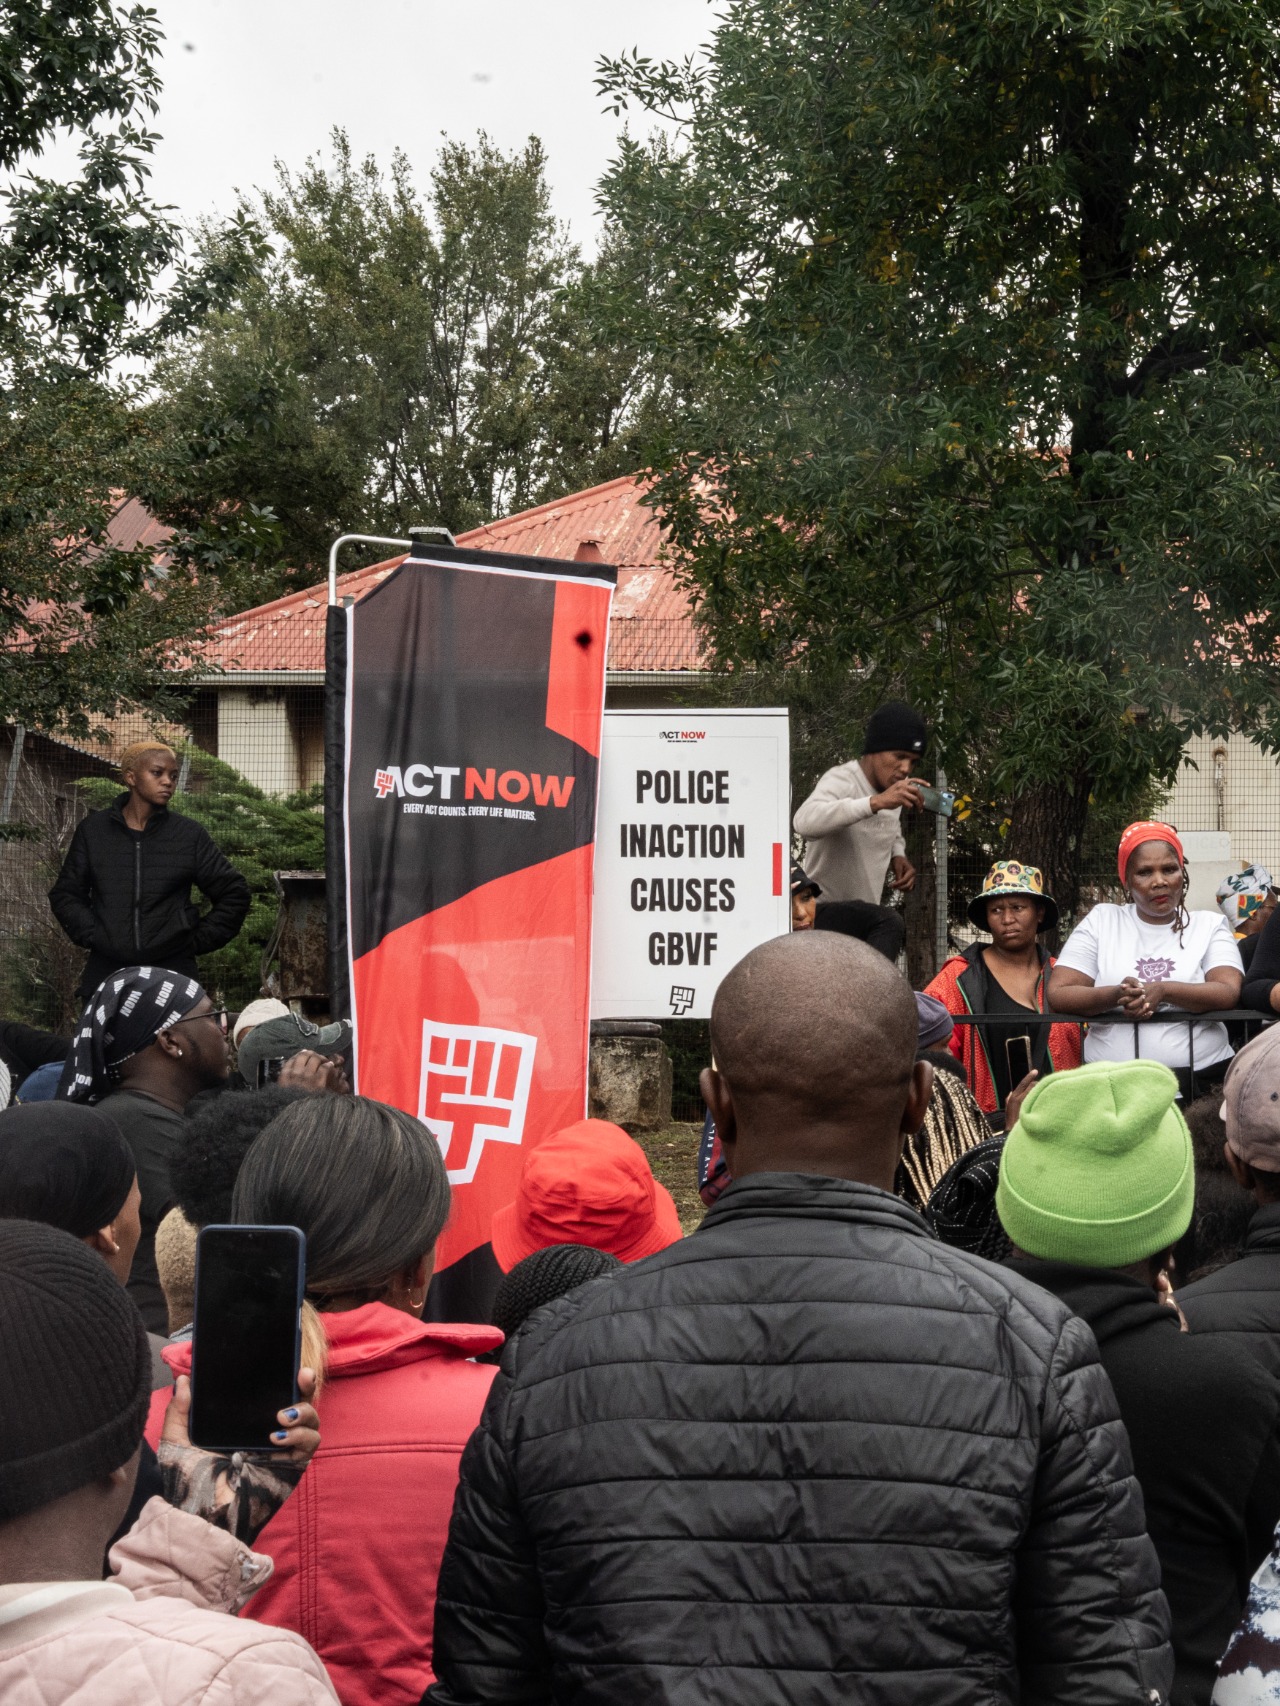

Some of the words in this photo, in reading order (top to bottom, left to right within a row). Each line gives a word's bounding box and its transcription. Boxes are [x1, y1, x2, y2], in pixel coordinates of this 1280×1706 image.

[660, 731, 680, 739] ACT
[681, 731, 706, 739] NOW
[374, 763, 460, 799] ACT
[464, 767, 576, 808] NOW
[636, 769, 730, 804] POLICE
[403, 803, 423, 814] EVERY
[424, 805, 438, 816] ACT
[438, 806, 468, 817] COUNTS.
[468, 807, 489, 818] EVERY
[489, 808, 503, 818] LIFE
[503, 809, 537, 821] MATTERS.
[620, 823, 745, 858] INACTION
[630, 877, 736, 912] CAUSES
[648, 931, 718, 966] GBVF
